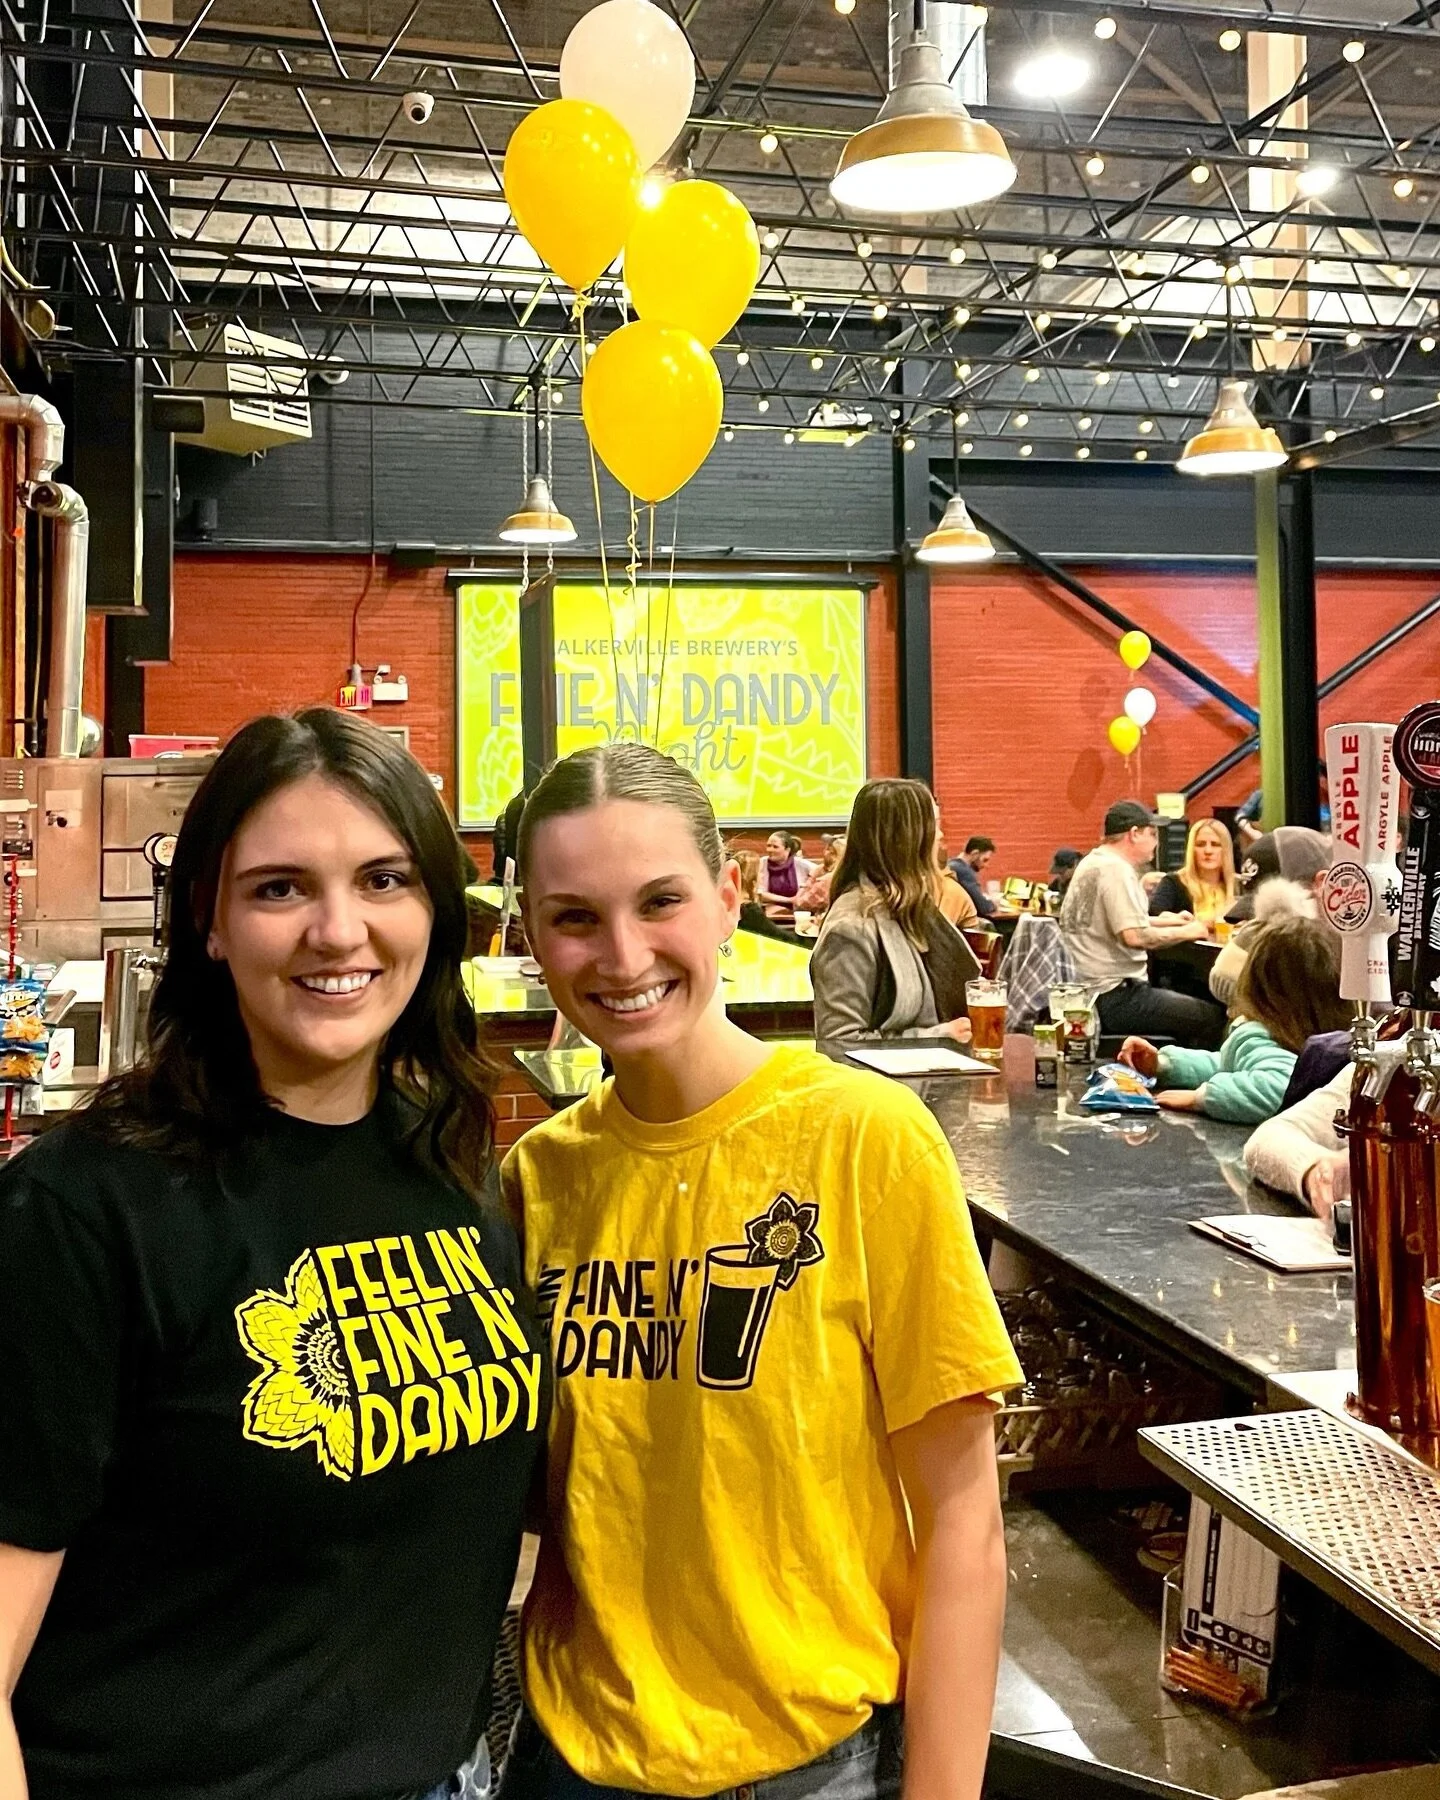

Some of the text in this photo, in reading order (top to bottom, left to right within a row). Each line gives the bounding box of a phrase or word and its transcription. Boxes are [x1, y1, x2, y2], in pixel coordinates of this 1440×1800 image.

[555, 639, 798, 656] ALKERVILLE BREWERY'S
[614, 672, 661, 727] N'
[682, 672, 840, 727] DANDY
[1342, 734, 1360, 850] APPLE
[1377, 735, 1393, 851] ARGYLE APPLE
[1397, 846, 1420, 961] WALKERVILLE
[1413, 872, 1427, 940] BREWERY
[316, 1226, 494, 1317] FEELIN'
[565, 1258, 700, 1318] FINE N'
[337, 1287, 530, 1393] FINE N'
[556, 1319, 687, 1381] DANDY
[358, 1353, 541, 1476] DANDY
